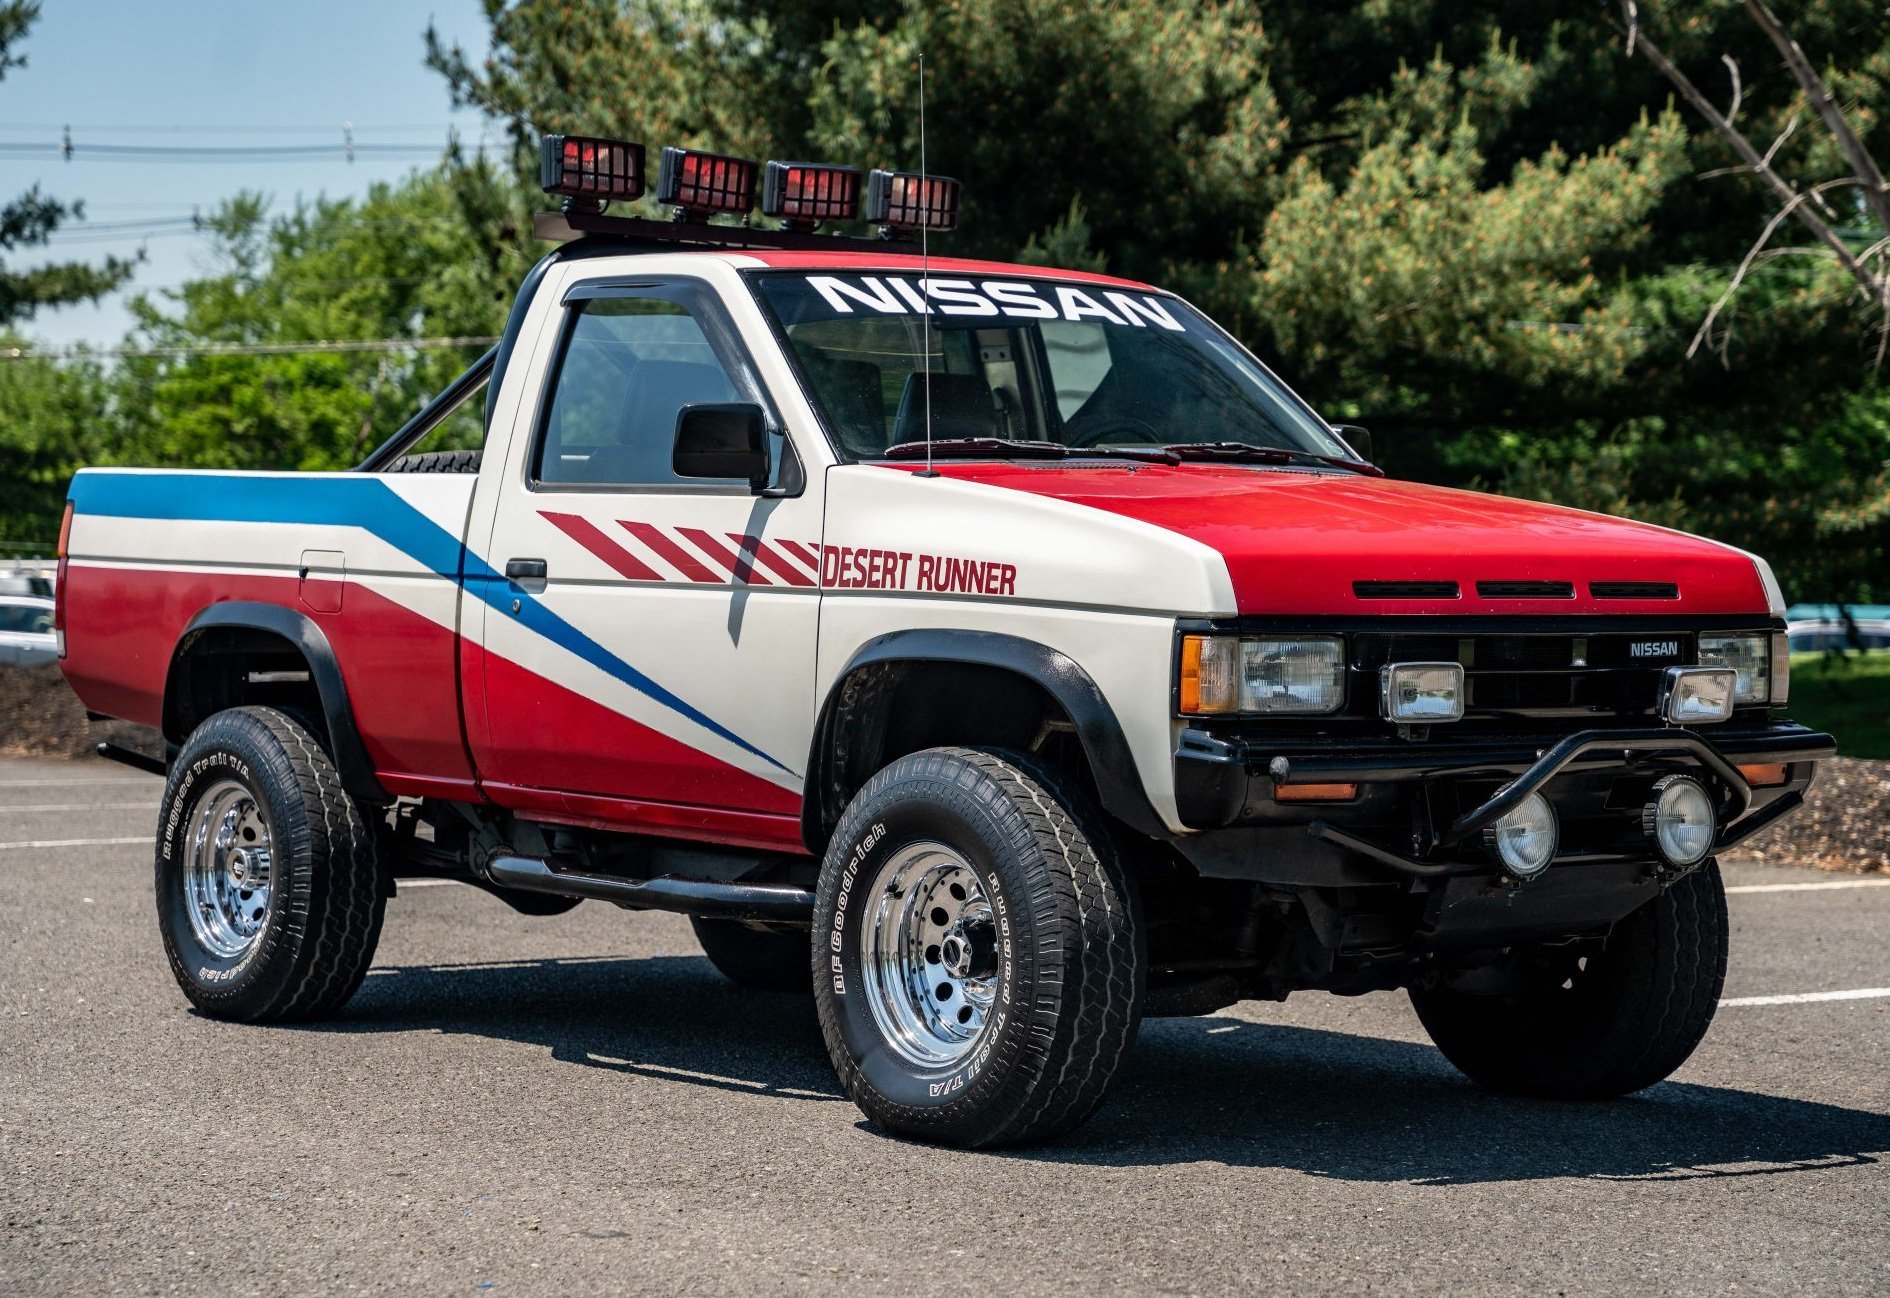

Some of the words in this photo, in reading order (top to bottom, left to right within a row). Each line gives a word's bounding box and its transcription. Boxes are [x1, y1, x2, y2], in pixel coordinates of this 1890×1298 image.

[805, 276, 1186, 332] NISSAN
[821, 544, 913, 589] DESERT
[916, 554, 1017, 596] RUNNER
[1631, 641, 1678, 657] NISSAN
[162, 769, 194, 861] Rugged
[193, 751, 228, 776] Trail
[831, 822, 887, 995] BFGoodrich
[987, 871, 1012, 1005] Rugged
[968, 1012, 1006, 1081] Trail
[929, 1074, 964, 1097] T/A
